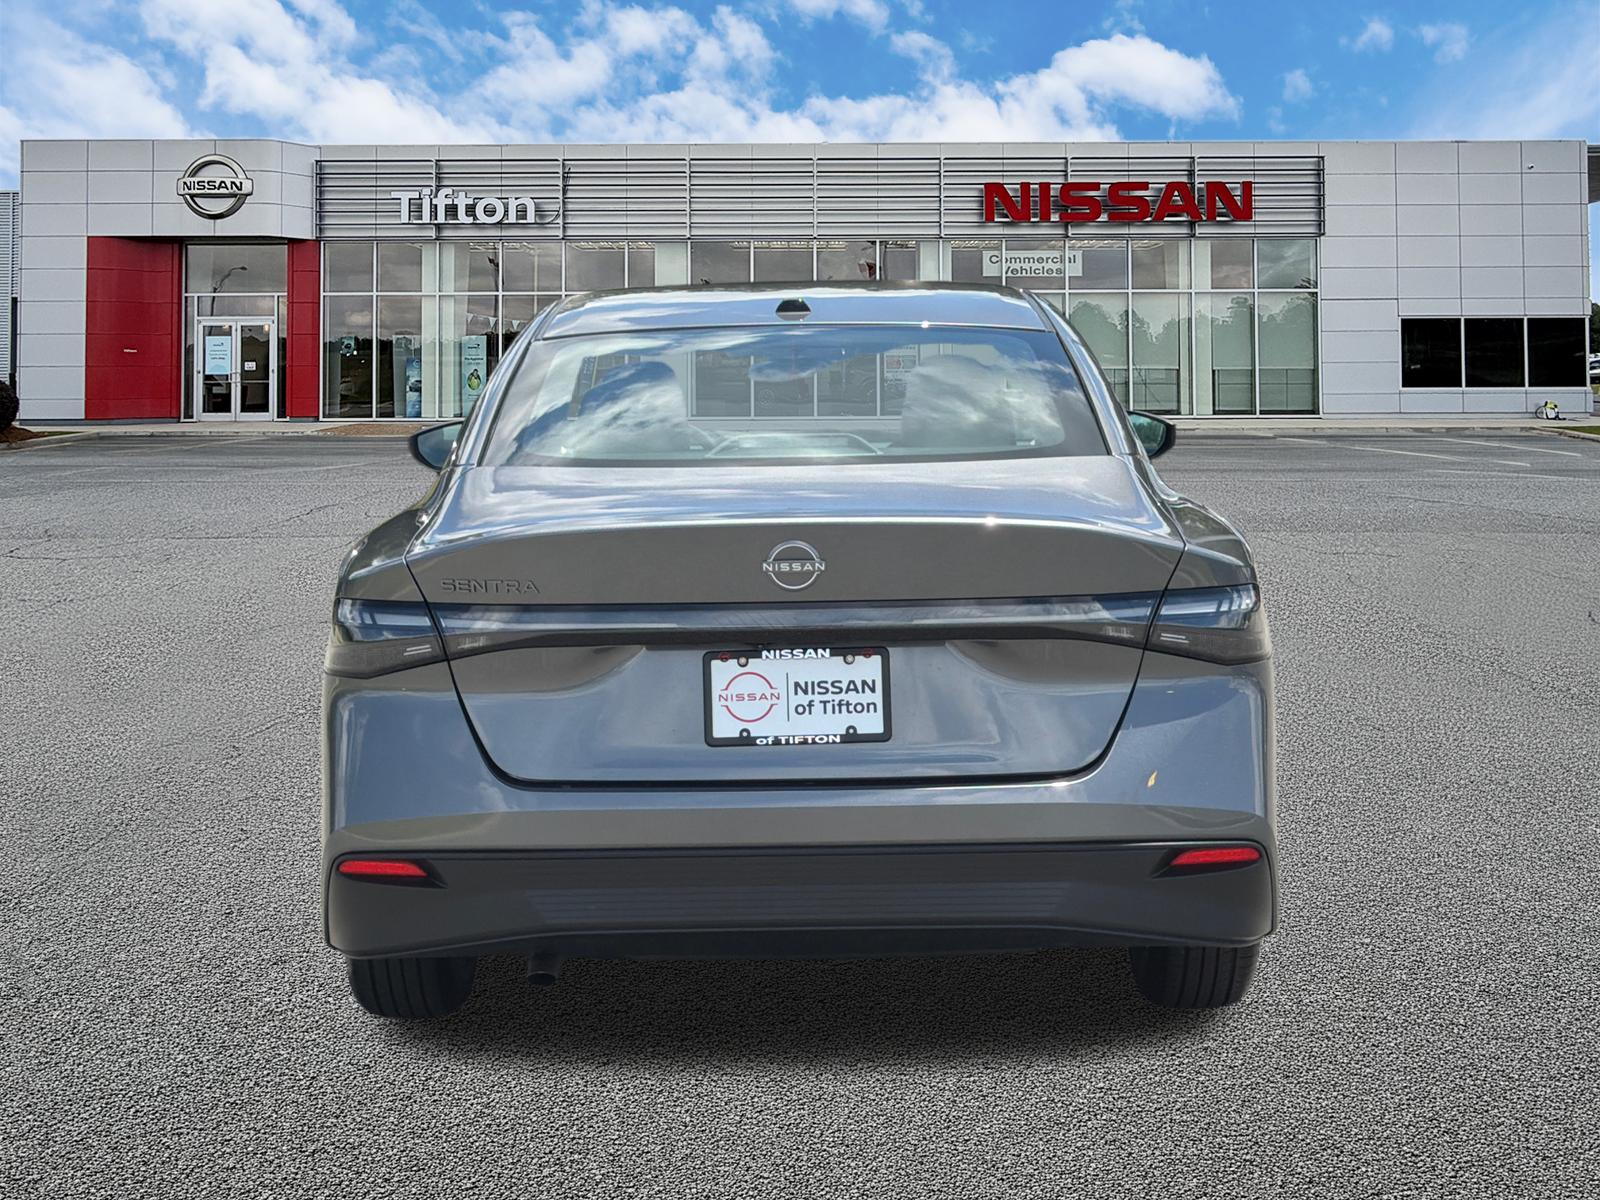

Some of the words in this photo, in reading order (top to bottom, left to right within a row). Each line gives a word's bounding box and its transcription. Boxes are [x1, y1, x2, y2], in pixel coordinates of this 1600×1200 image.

[182, 180, 243, 191] NISSAN
[391, 188, 536, 224] Tifton
[983, 181, 1253, 222] NISSAN
[762, 562, 825, 572] NISSAN
[440, 578, 540, 593] SENTRA
[761, 648, 831, 660] NISSAN
[793, 679, 876, 696] NISSAN
[718, 692, 781, 702] NISSAN
[794, 702, 815, 716] of
[819, 699, 878, 716] Tifton
[755, 735, 774, 746] of
[777, 734, 841, 745] TIFTON
